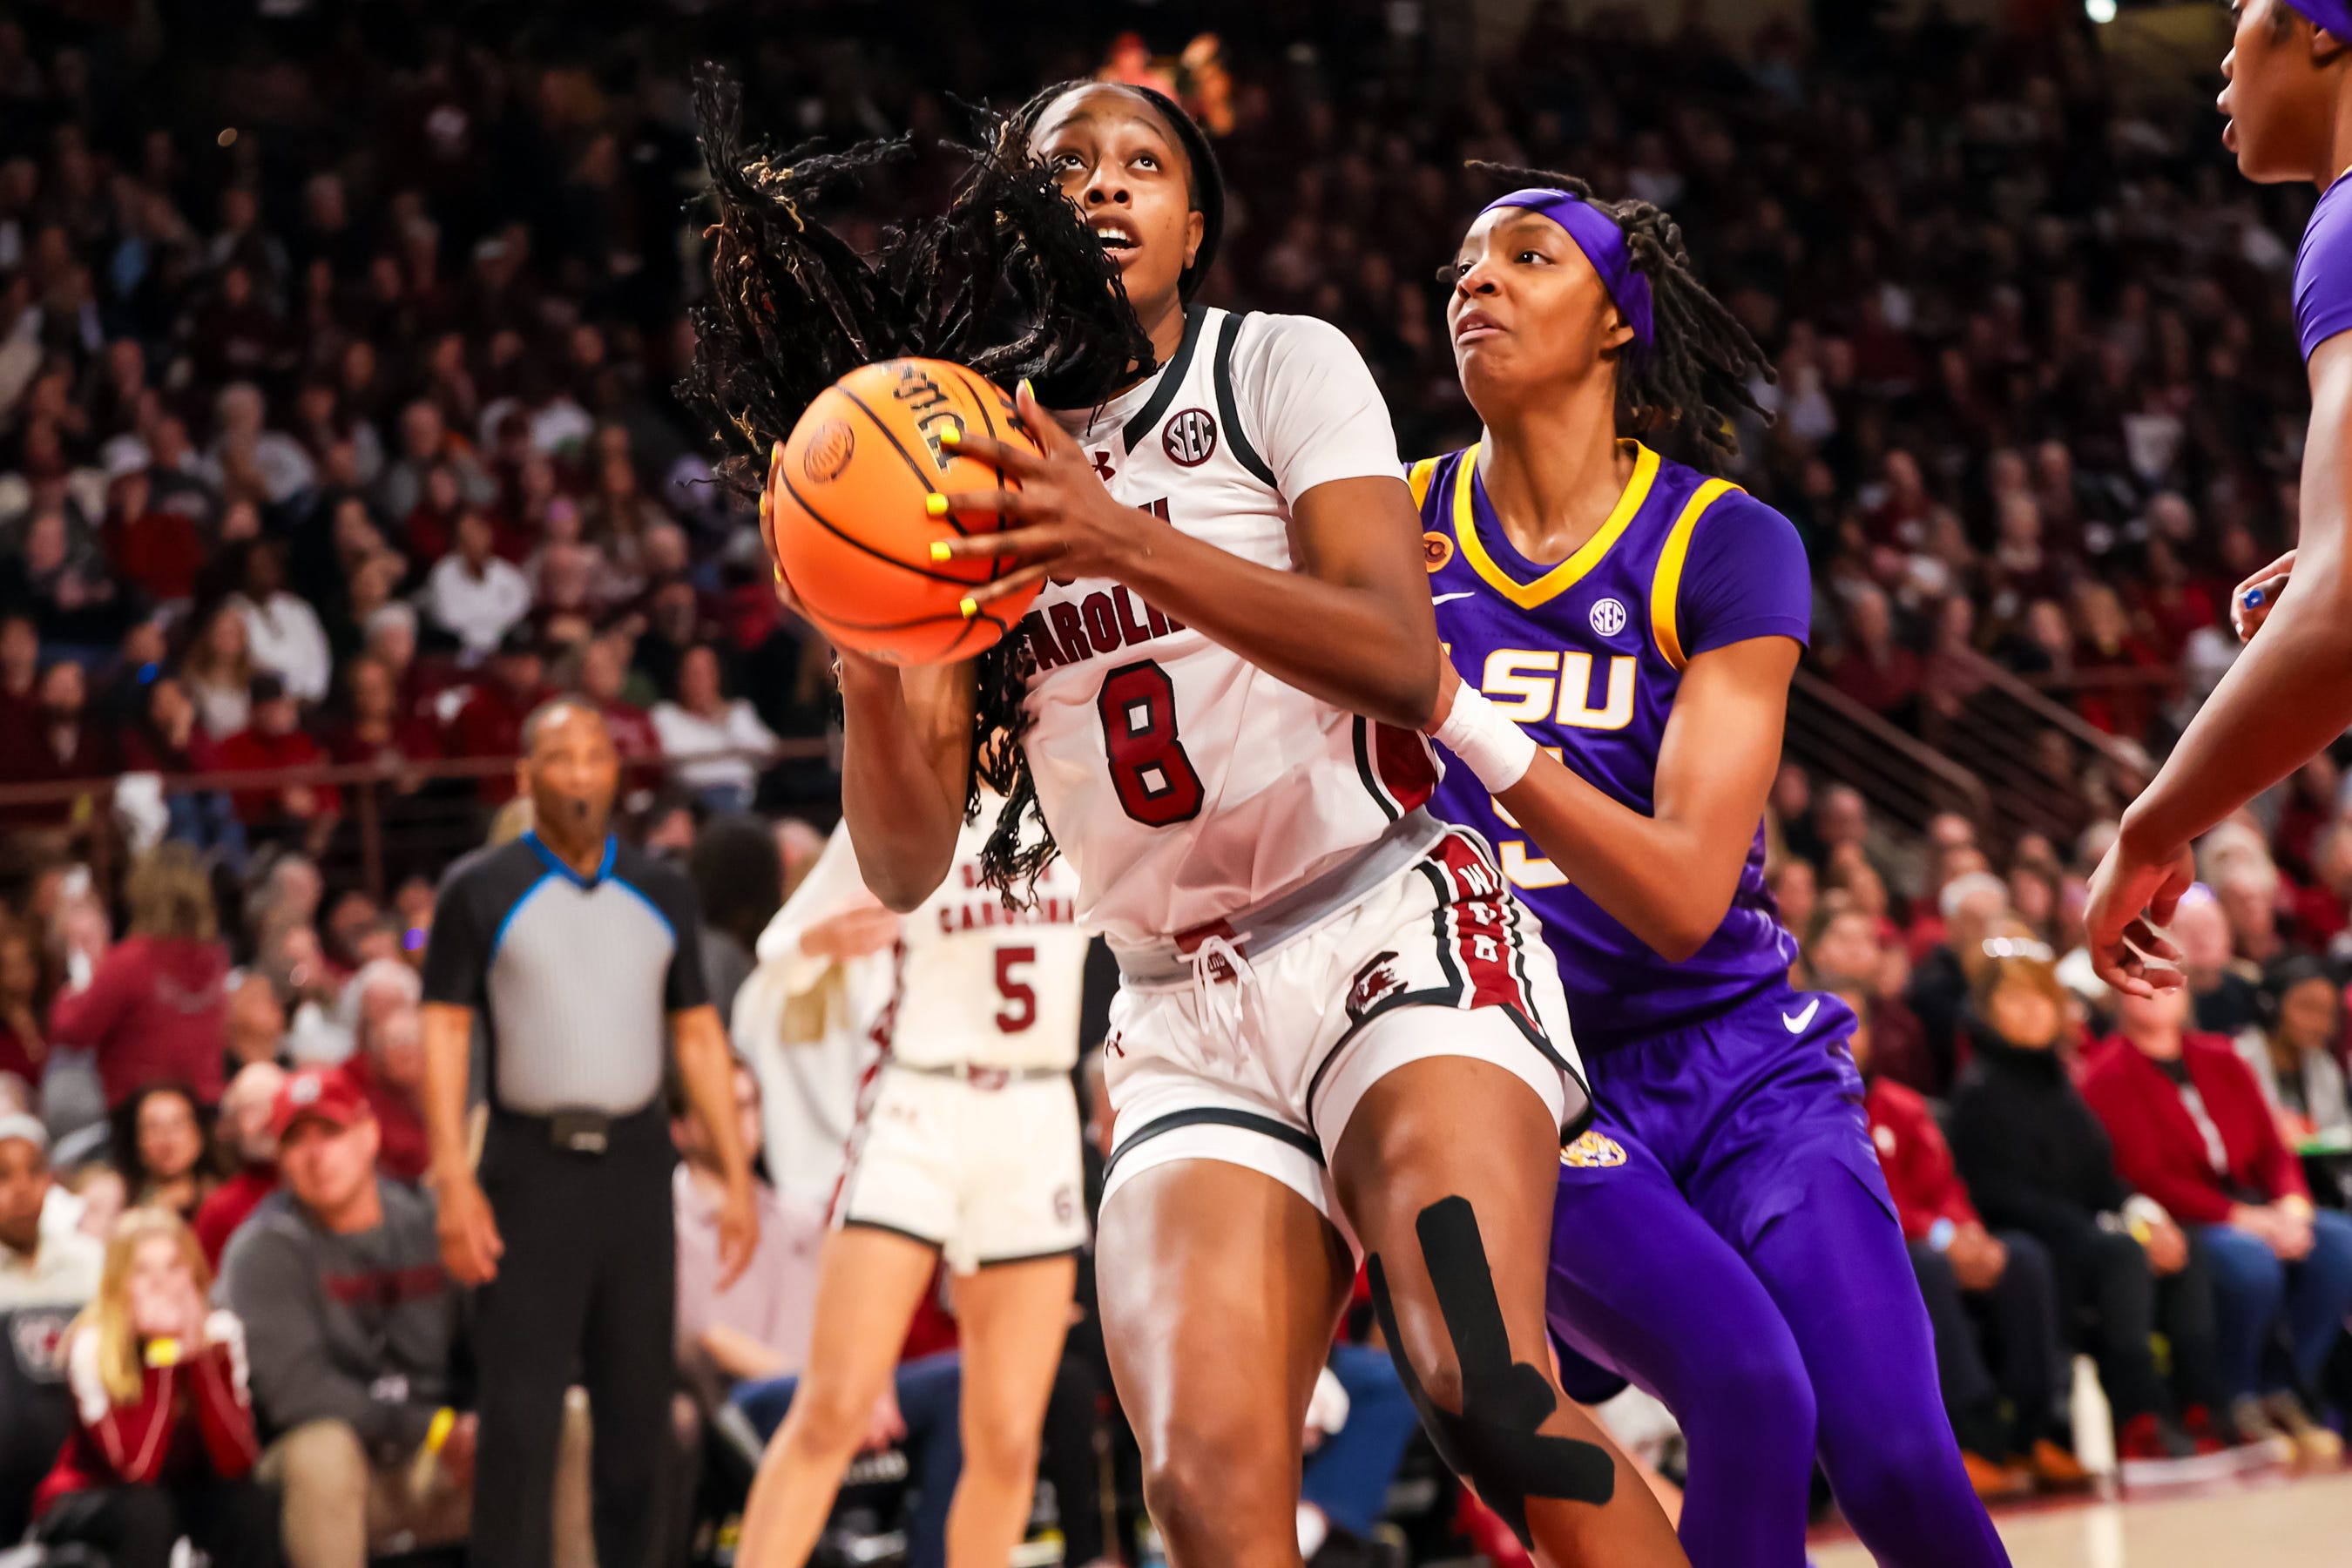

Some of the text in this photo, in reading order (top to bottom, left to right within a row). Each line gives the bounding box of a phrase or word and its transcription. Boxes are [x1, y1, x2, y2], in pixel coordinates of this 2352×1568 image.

[1166, 410, 1213, 463] SEC
[1592, 600, 1624, 633] SEC
[1439, 643, 1638, 731] SU
[1097, 659, 1206, 828] 8
[995, 946, 1037, 1034] 5
